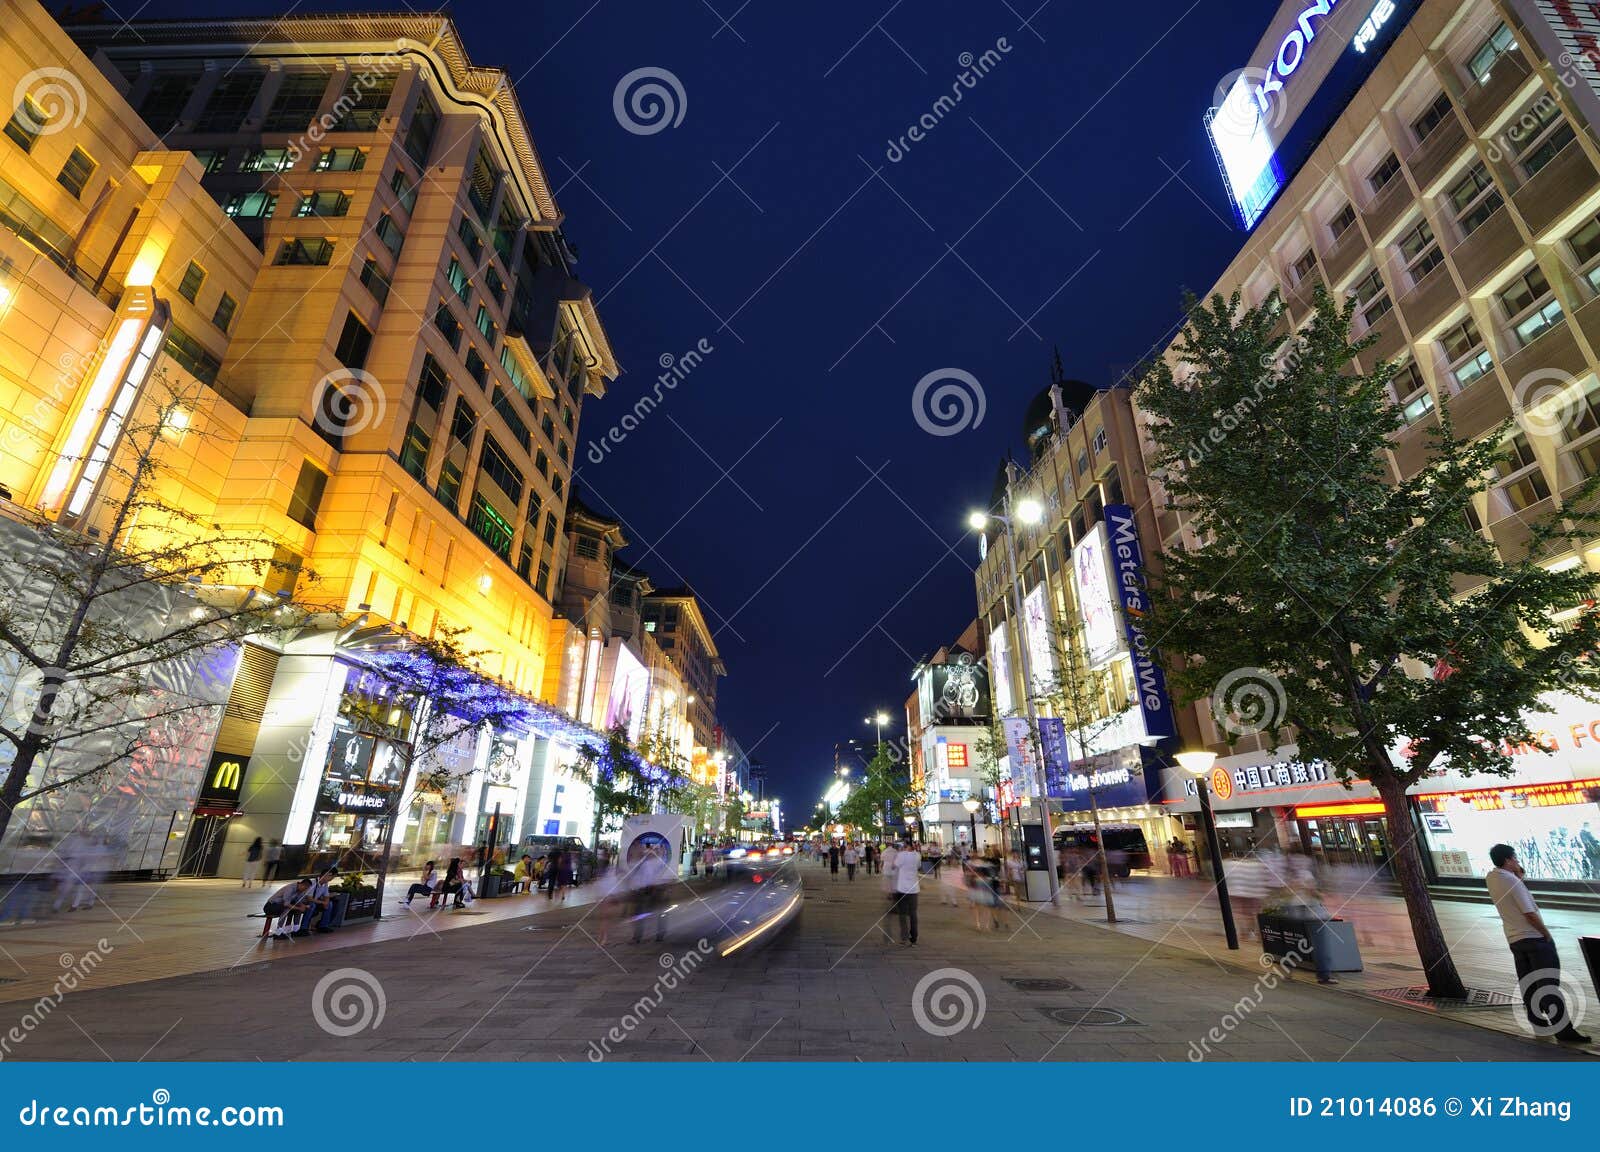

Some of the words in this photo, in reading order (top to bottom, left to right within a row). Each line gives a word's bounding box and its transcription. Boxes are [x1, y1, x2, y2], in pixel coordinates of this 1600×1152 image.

[1255, 0, 1337, 113] KON
[1234, 758, 1328, 791] 中国工商银行
